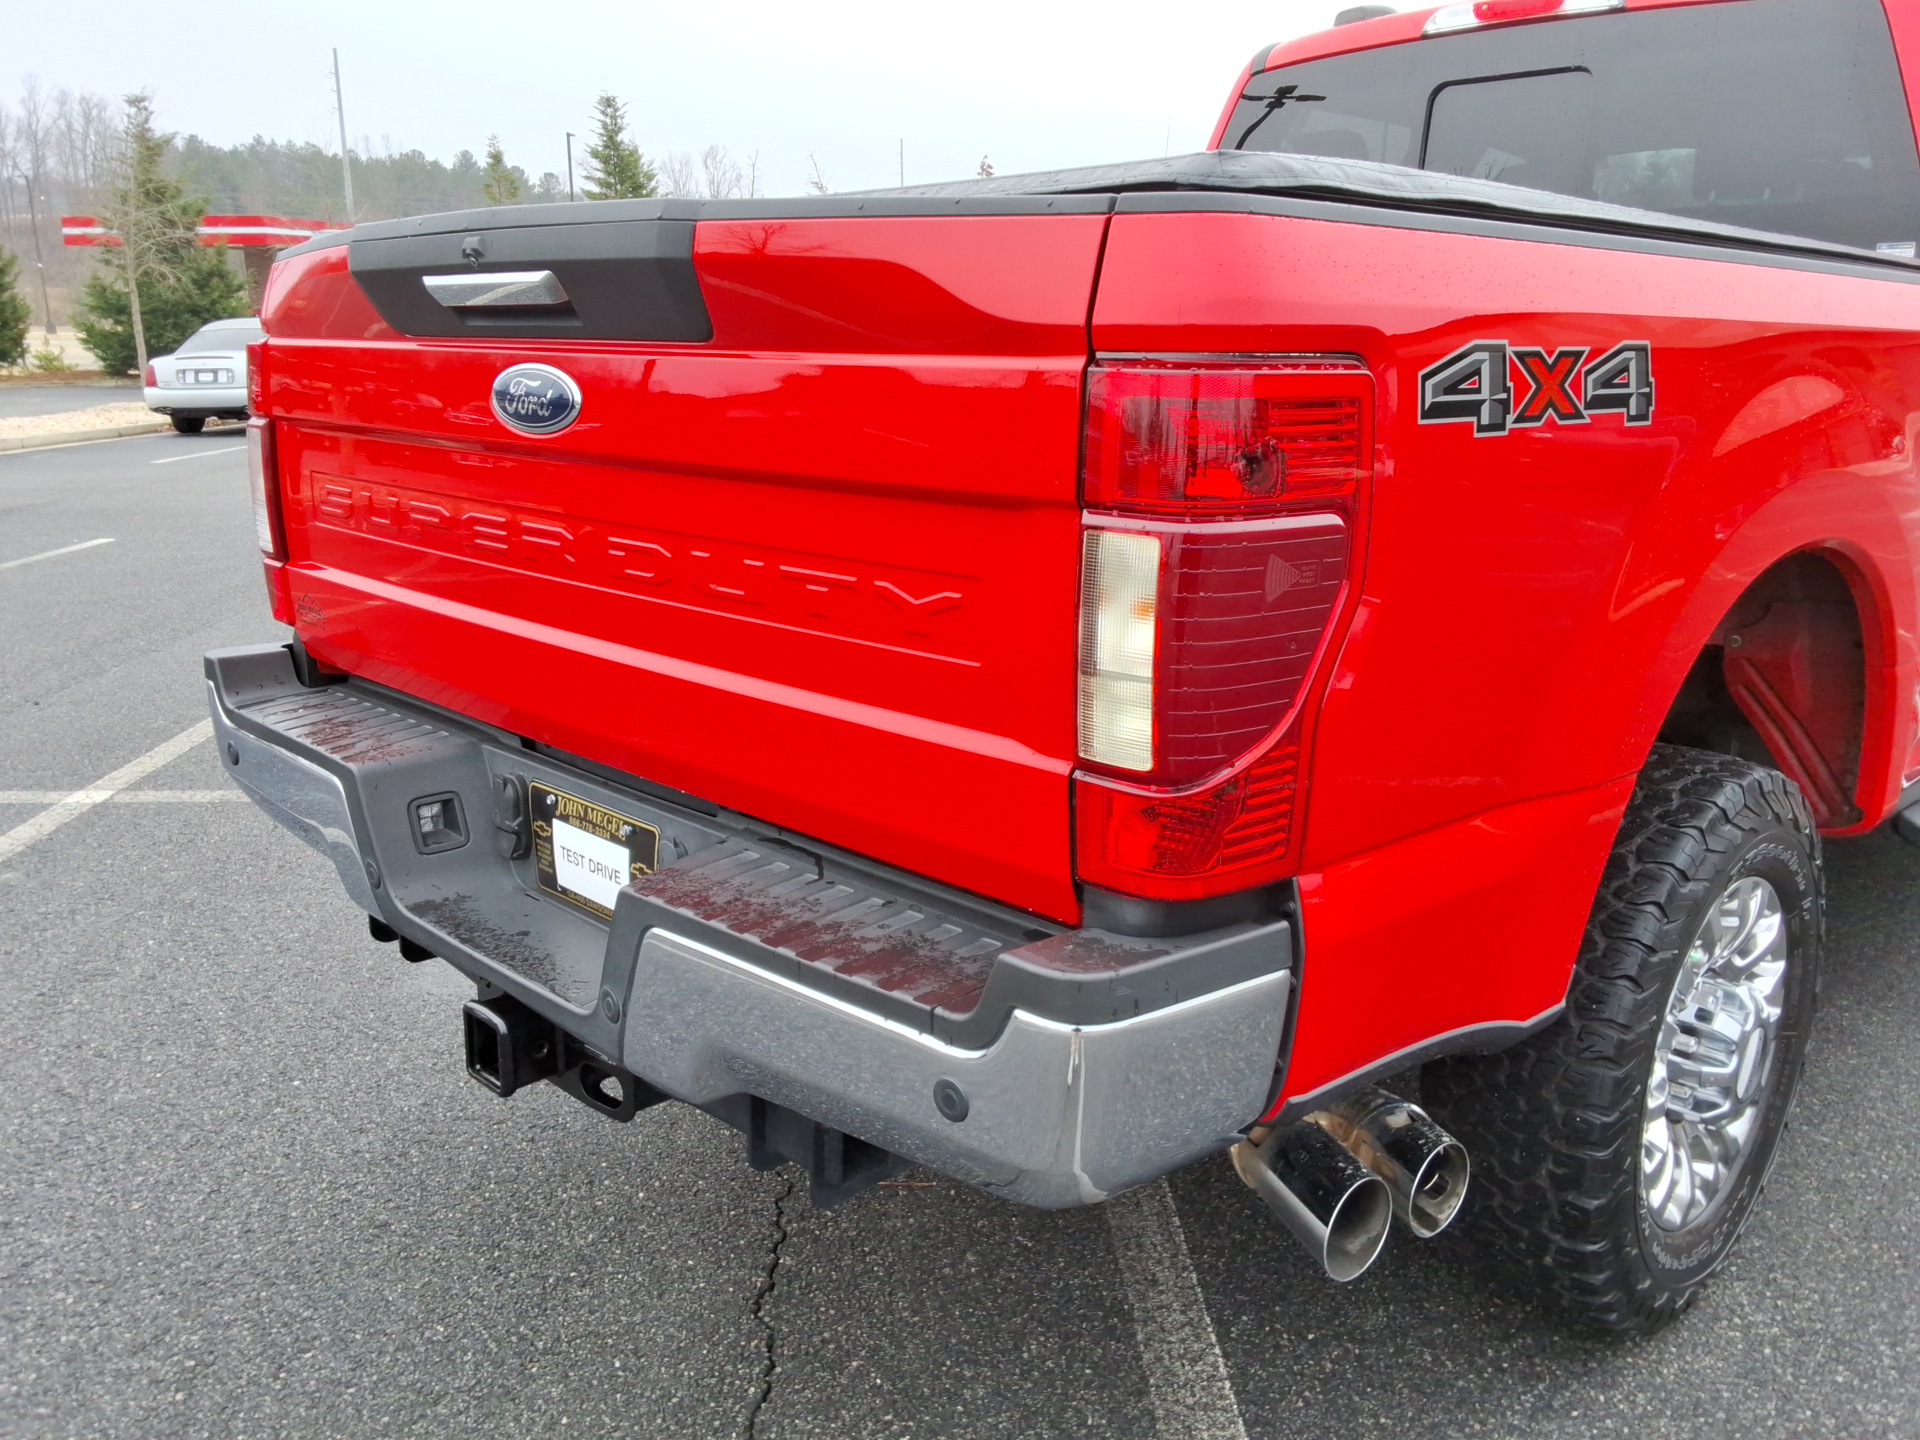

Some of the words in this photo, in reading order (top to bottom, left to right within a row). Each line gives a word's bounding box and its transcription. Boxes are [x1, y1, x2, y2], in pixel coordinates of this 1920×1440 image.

[505, 377, 554, 417] Ford
[319, 483, 577, 568] SUPER
[608, 535, 963, 638] DUTY
[555, 796, 586, 817] JOHN
[560, 845, 586, 869] TEST
[588, 857, 622, 885] DRIVE
